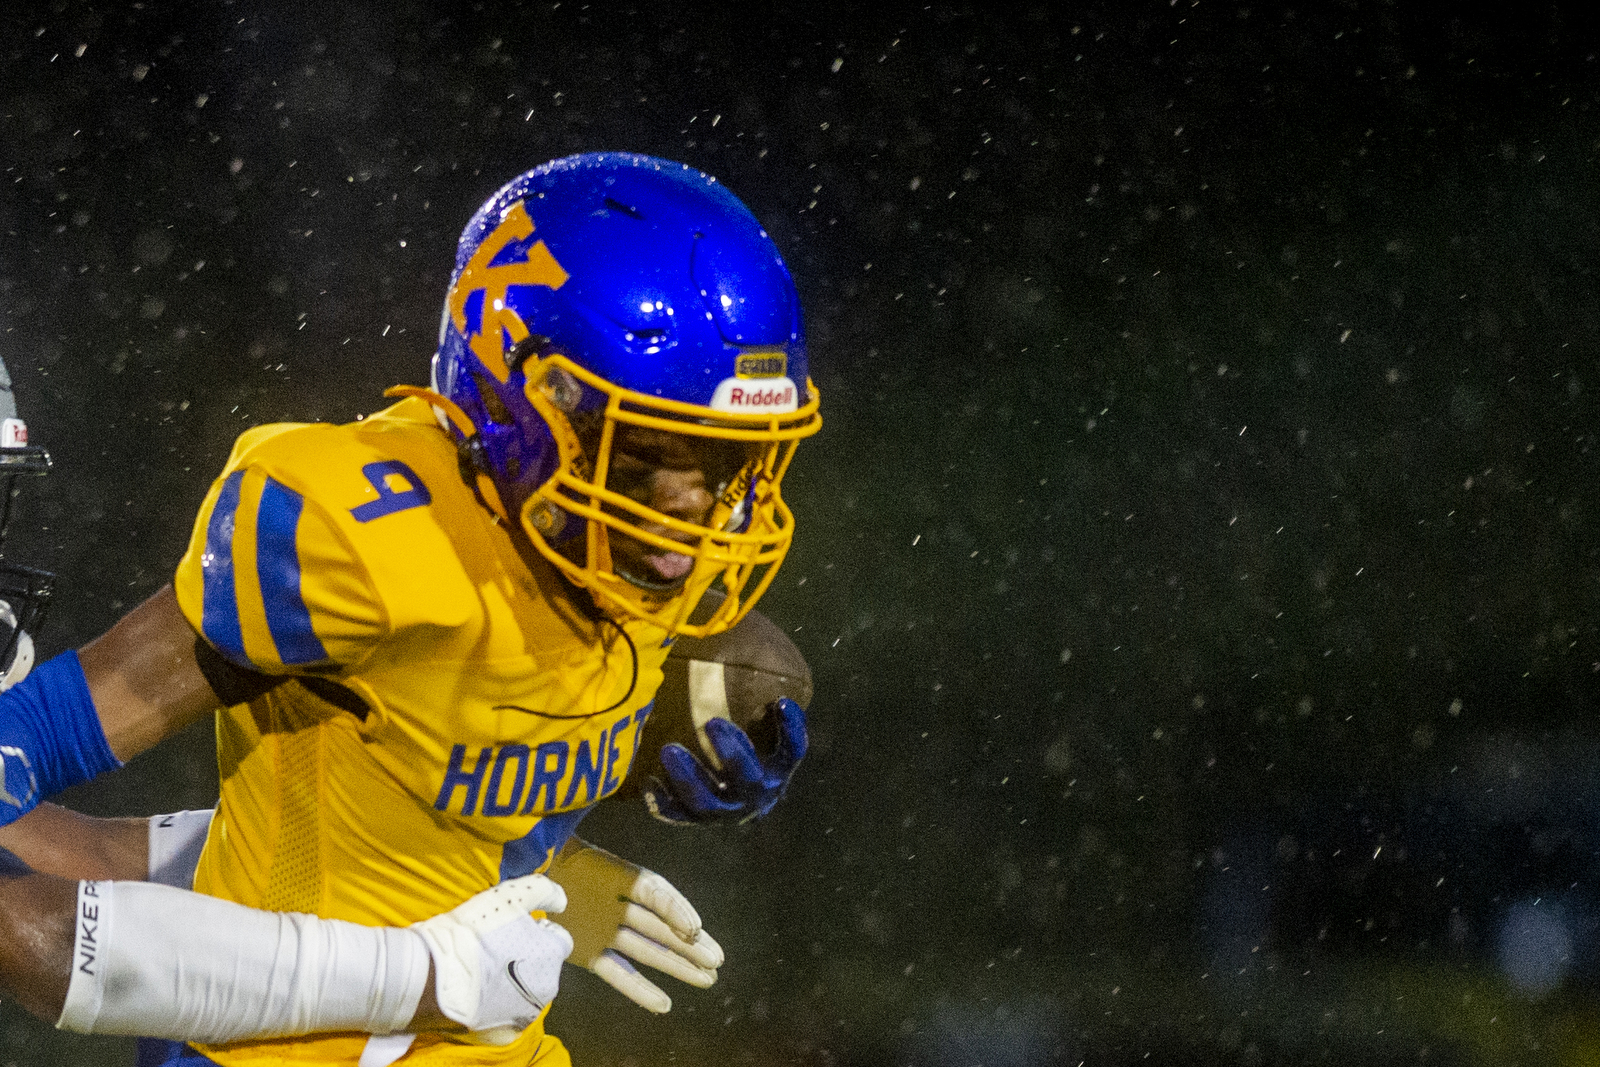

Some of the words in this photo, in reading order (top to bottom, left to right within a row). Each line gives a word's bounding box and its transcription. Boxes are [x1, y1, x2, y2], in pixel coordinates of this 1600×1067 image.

[730, 387, 793, 406] Riddell
[349, 459, 432, 524] 9
[80, 901, 99, 976] NIKE
